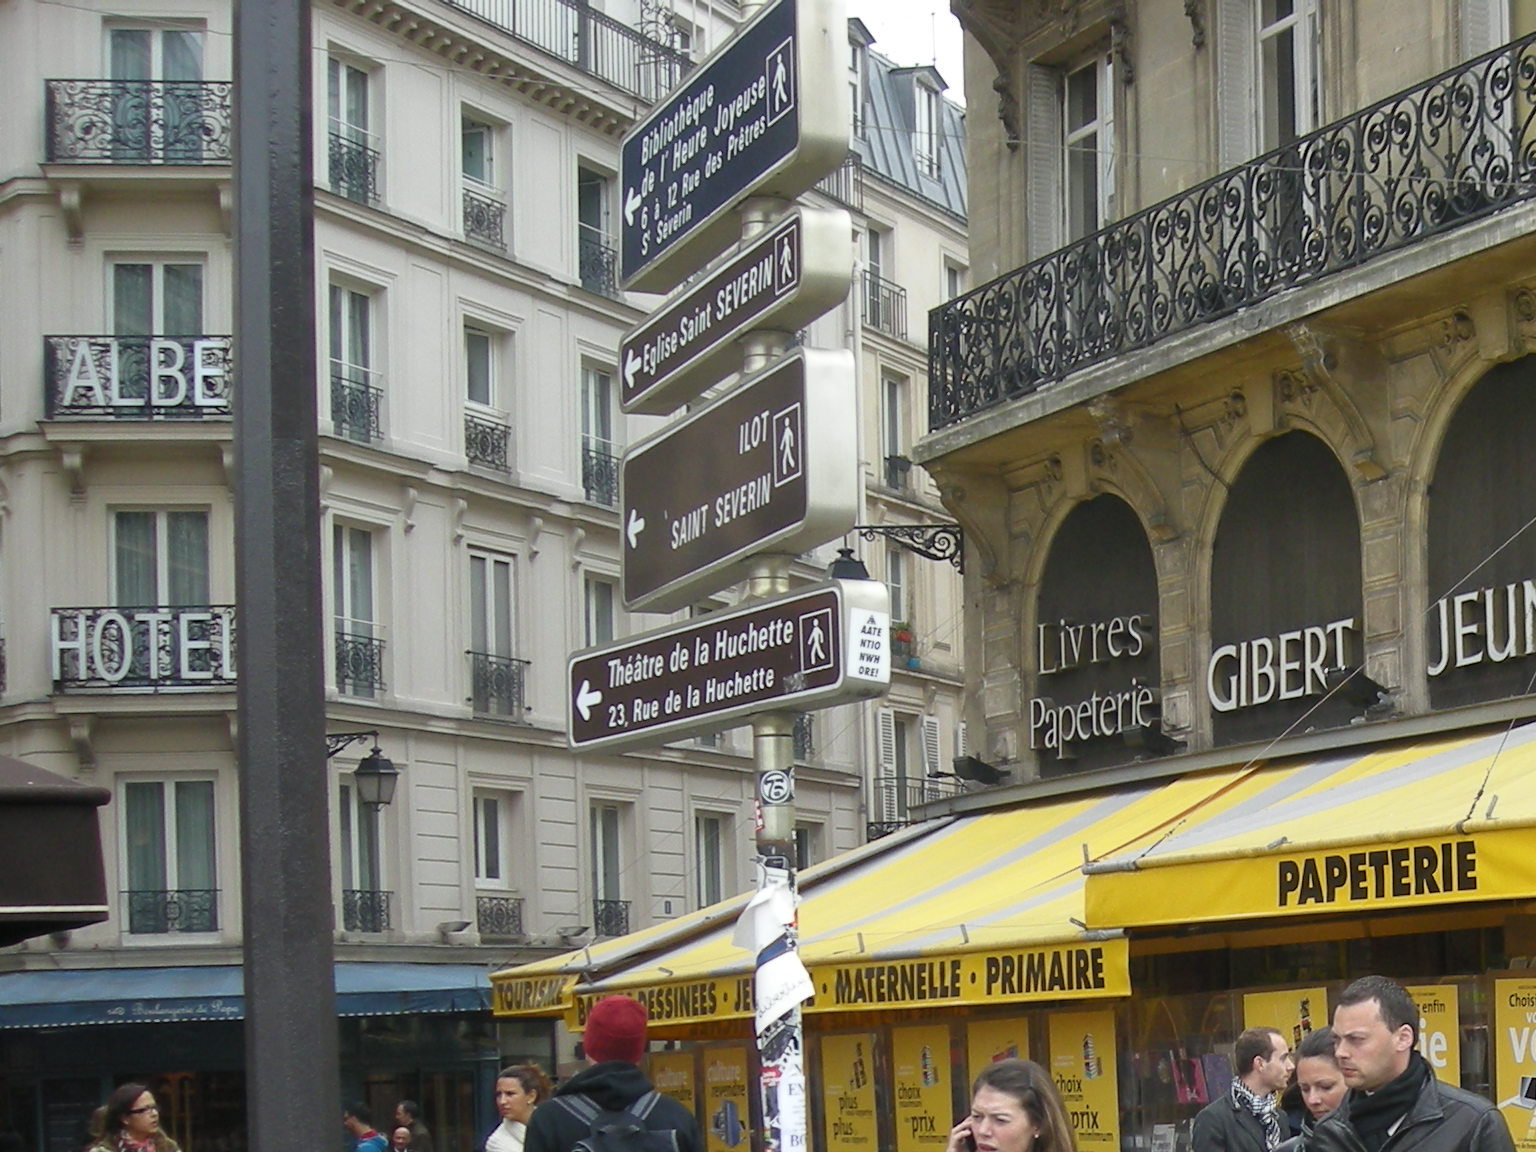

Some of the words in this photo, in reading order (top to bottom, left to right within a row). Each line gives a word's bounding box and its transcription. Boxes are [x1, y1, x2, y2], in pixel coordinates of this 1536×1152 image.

[641, 84, 714, 166] Bibliothèque
[641, 171, 655, 197] de
[672, 126, 707, 172] Heure
[714, 75, 766, 137] Joyeuse
[640, 207, 648, 230] 6
[653, 197, 661, 220] à
[668, 184, 678, 209] 12
[682, 172, 700, 197] Rue
[705, 153, 722, 178] des
[727, 115, 766, 161] Prêtres
[656, 203, 692, 246] Séverin
[643, 334, 677, 375] Eglise
[679, 303, 711, 346] Saint
[716, 254, 774, 322] SEVERIN
[739, 410, 770, 455] ILOT
[671, 504, 708, 550] SAINT
[715, 473, 772, 528] SEVERIN
[51, 611, 237, 681] HOTEL
[608, 651, 664, 688] Théâtre
[669, 642, 688, 671] de
[694, 638, 710, 667] la
[715, 617, 794, 661] Huchette
[1037, 613, 1144, 675] Livres
[1207, 617, 1356, 712] GIBERT
[608, 705, 628, 728] 23,
[633, 699, 658, 723] Rue
[664, 690, 681, 713] de
[687, 685, 700, 708] la
[705, 667, 775, 704] Huchette
[1031, 676, 1154, 759] Papeterie
[1278, 841, 1478, 907] PAPETERIE
[497, 978, 567, 1010] TOURISME
[637, 981, 717, 1020] DESSINEES
[835, 959, 961, 1004] MATERNELLE
[986, 948, 1105, 996] PRIMAIRE
[1422, 1000, 1446, 1013] enfin
[1418, 1018, 1448, 1067] ie
[838, 1092, 858, 1112] plus
[897, 1083, 921, 1099] choix
[1071, 1105, 1099, 1129] prix
[832, 1118, 853, 1140] plus
[911, 1111, 936, 1139] prix
